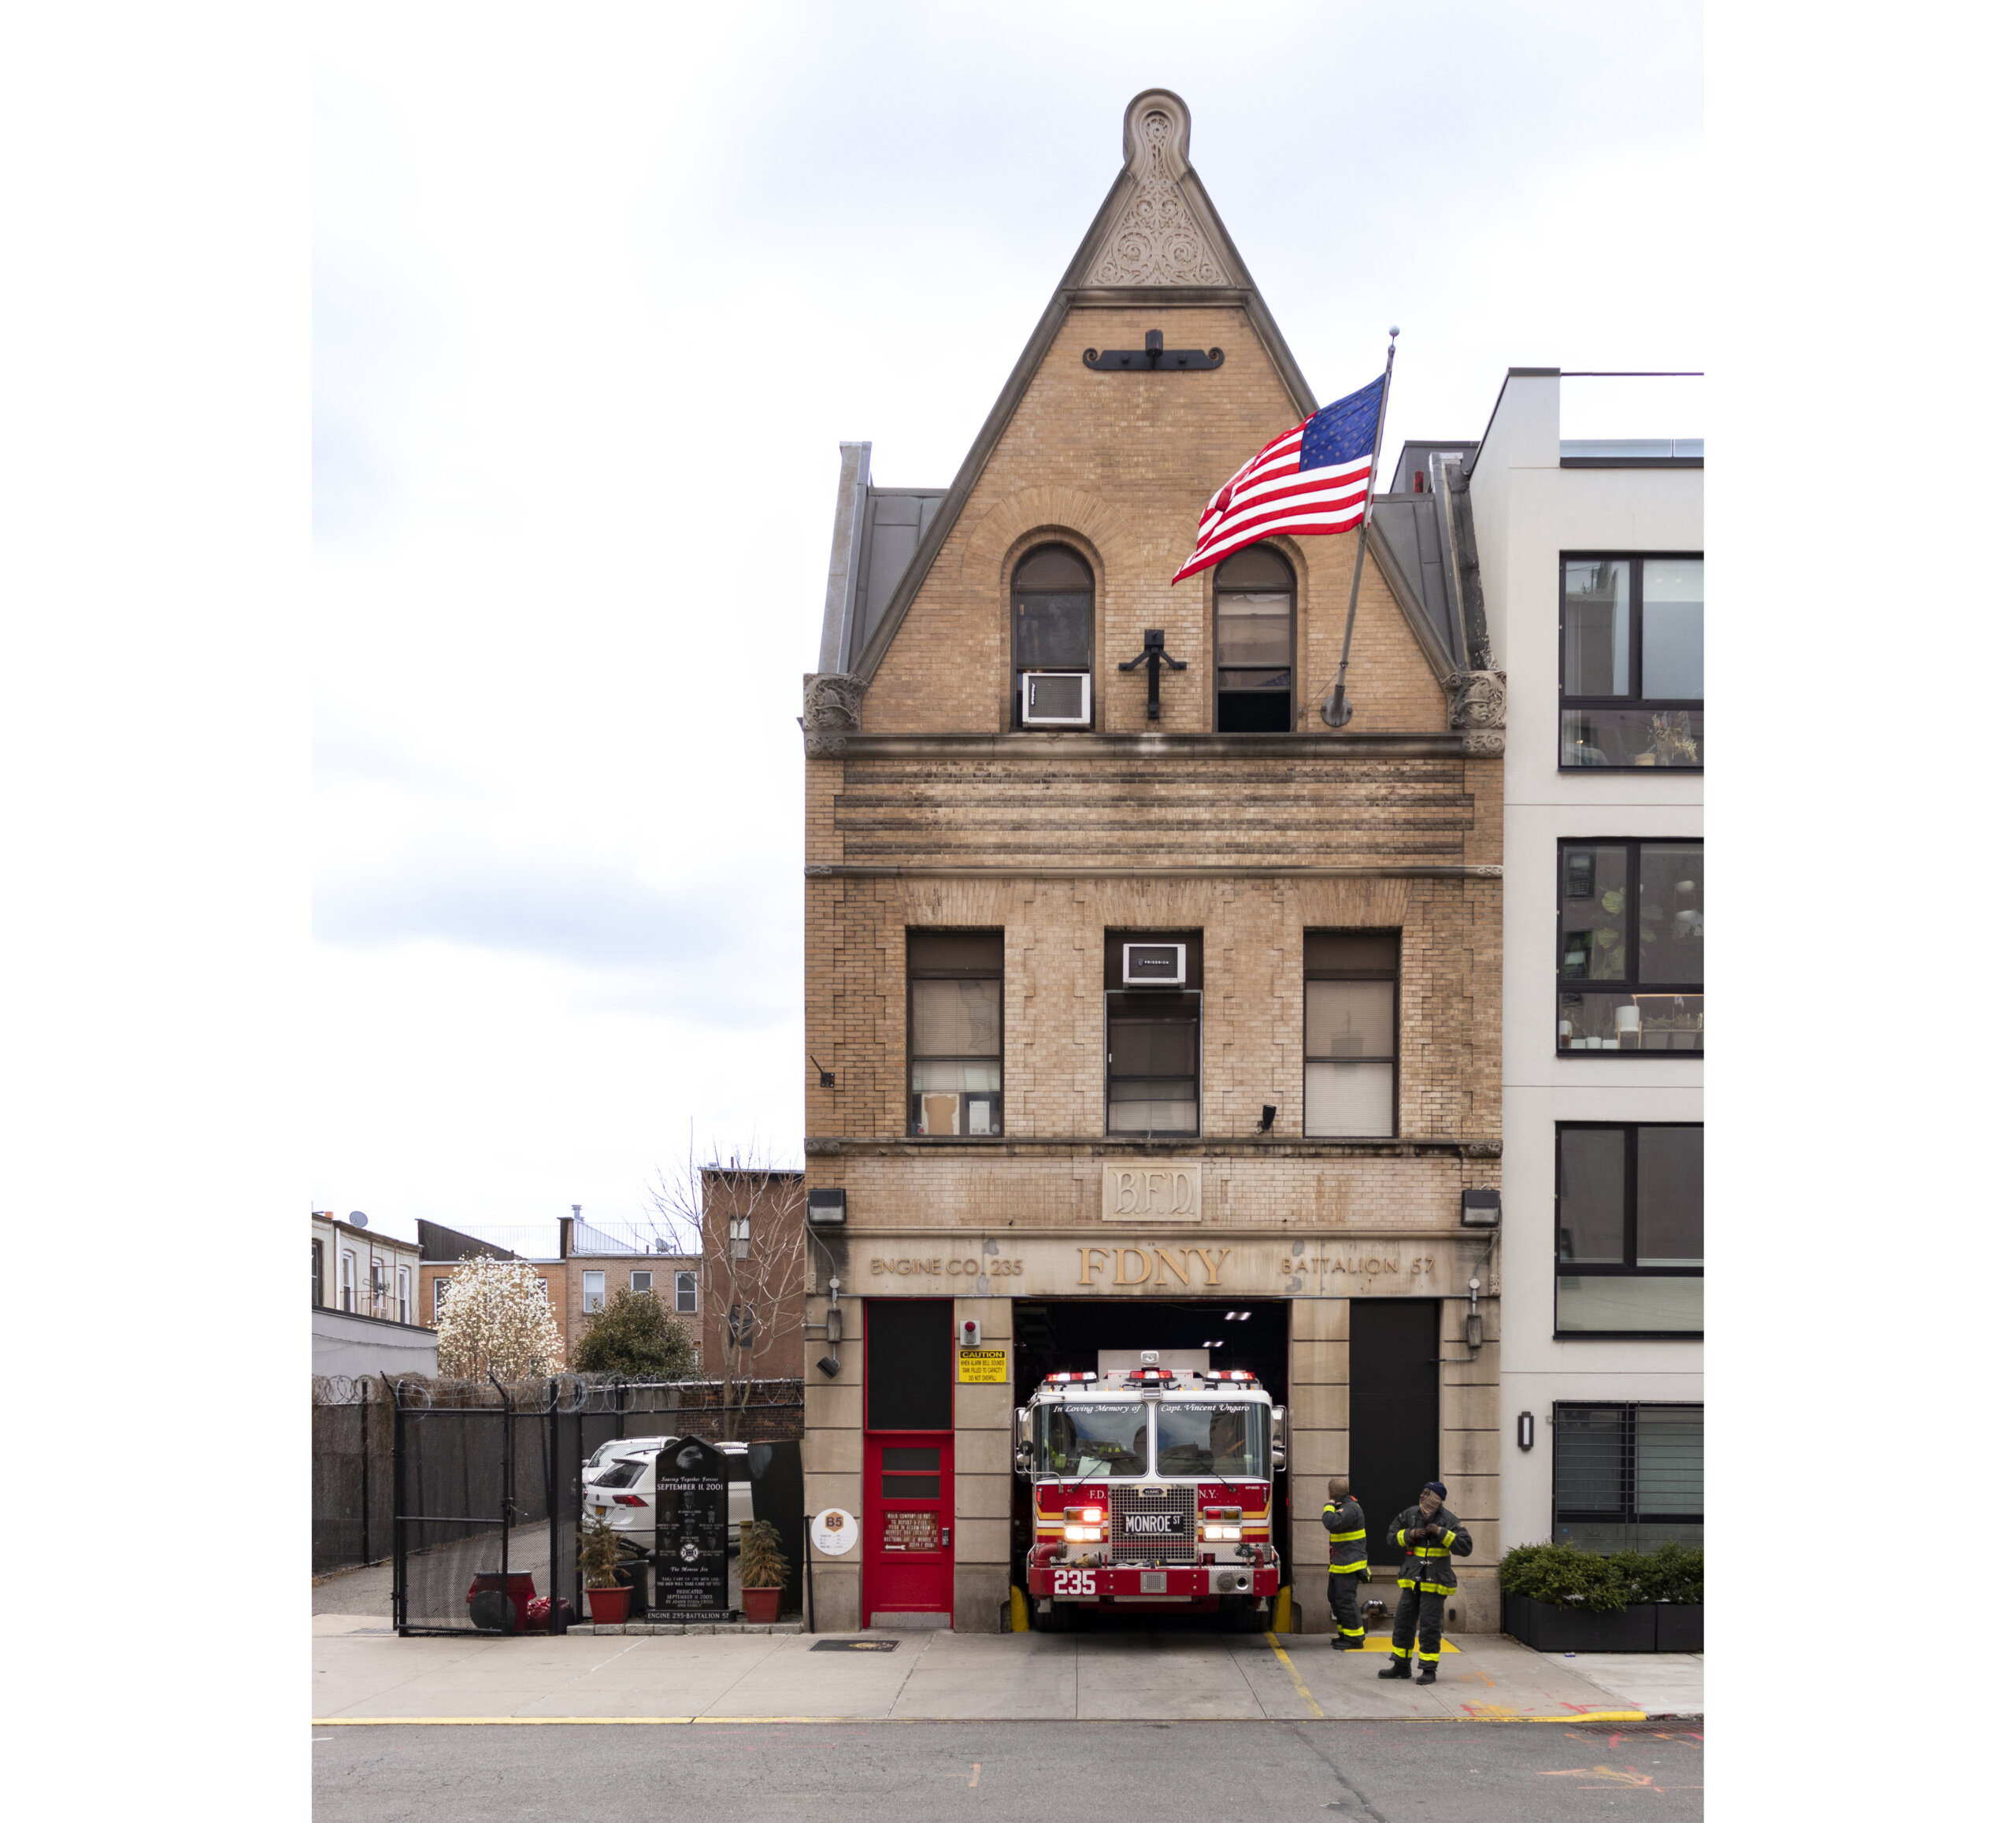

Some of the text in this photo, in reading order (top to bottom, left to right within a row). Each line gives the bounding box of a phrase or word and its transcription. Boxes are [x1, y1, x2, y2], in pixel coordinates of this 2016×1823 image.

[1114, 1171, 1195, 1215] B.F.D.
[870, 1258, 941, 1275] ENGINE
[991, 1258, 1022, 1275] 235
[1077, 1247, 1230, 1286] FDNY
[1282, 1257, 1436, 1274] BATTALION 57
[1064, 1404, 1094, 1414] Loving
[1095, 1404, 1129, 1414] Memory
[1132, 1403, 1143, 1413] of
[1161, 1405, 1182, 1414] Capt.
[1219, 1404, 1250, 1413] Ungaro
[1089, 1490, 1106, 1499] F.D.
[1199, 1489, 1217, 1499] N.Y.
[826, 1517, 843, 1527] B5
[1125, 1515, 1181, 1532] MONROE ST
[1054, 1570, 1095, 1595] 235
